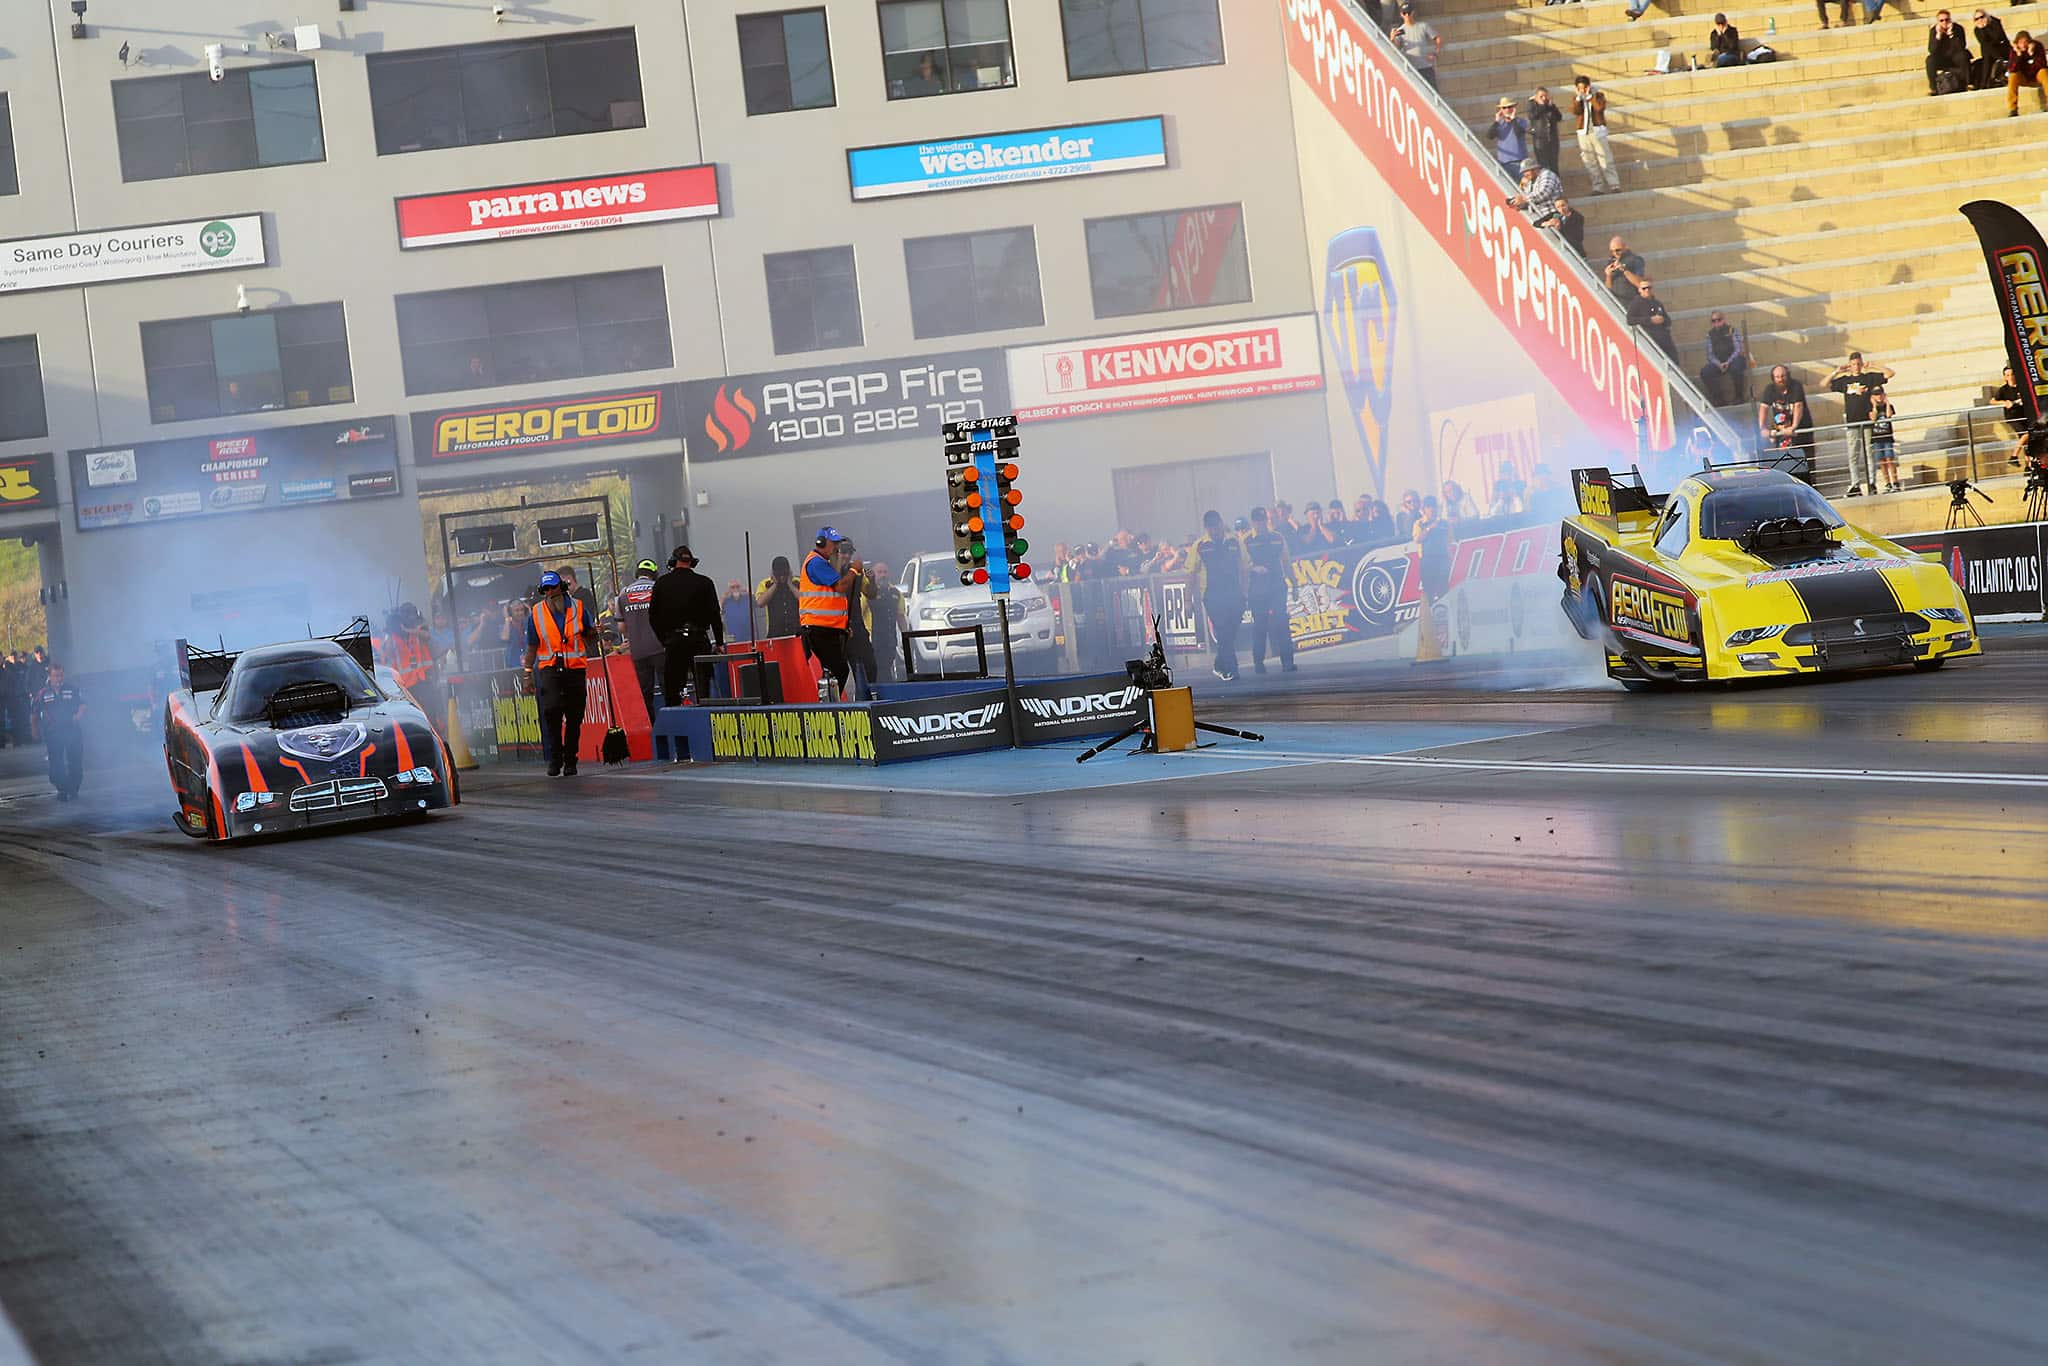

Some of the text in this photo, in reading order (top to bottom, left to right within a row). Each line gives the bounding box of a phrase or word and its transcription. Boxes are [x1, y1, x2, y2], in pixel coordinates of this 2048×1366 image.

[919, 142, 974, 155] the western
[920, 136, 1095, 175] weekender
[468, 181, 646, 226] parra news
[498, 223, 571, 238] parranews.com.au
[14, 234, 184, 263] Same Day Couriers
[2005, 273, 2040, 383] PERFORMANCE PRODUCTS
[1090, 334, 1276, 382] KENWORTH
[762, 364, 984, 415] ASAP Fire
[439, 396, 657, 452] AEROFLOW
[768, 399, 985, 443] 1300 282 727
[956, 417, 1012, 431] PRE-STAGE
[1018, 407, 1059, 419] GILBERT
[1069, 402, 1103, 413] ROACH
[454, 434, 549, 451] PERFORMANCE PRODUCTS
[970, 440, 999, 452] STAGE
[200, 456, 269, 473] CHAMPIONSHIP
[1968, 556, 2014, 594] ATLANTIC
[2015, 555, 2039, 593] OILS
[1289, 608, 1350, 637] SHIFT
[1612, 579, 1690, 641] AEROFLOW
[1029, 688, 1136, 718] NDRC
[888, 704, 998, 736] NDRC
[1034, 719, 1060, 727] NATIONAL
[1096, 710, 1137, 720] CHAMPIONSHIP
[893, 737, 919, 745] NATIONAL
[955, 728, 996, 738] CHAMPIONSHIP
